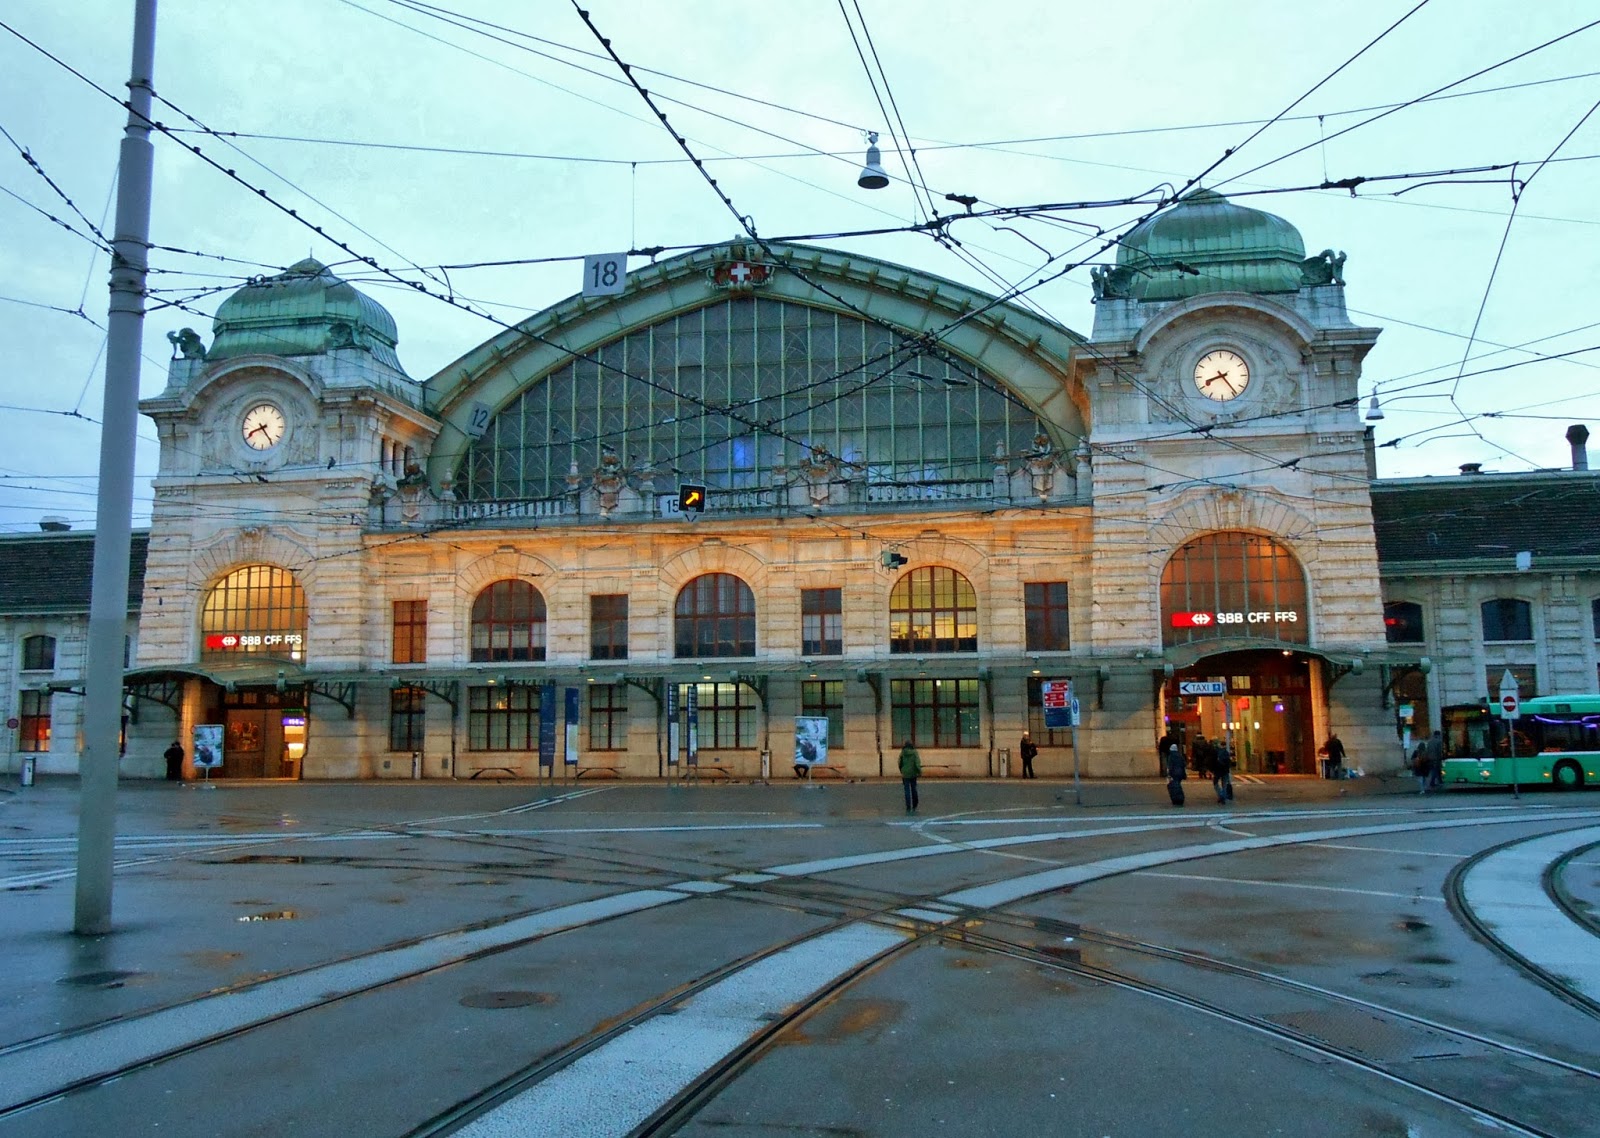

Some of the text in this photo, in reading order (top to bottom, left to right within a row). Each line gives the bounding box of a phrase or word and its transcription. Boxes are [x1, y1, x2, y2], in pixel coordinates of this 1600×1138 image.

[592, 261, 618, 288] 18
[472, 408, 488, 429] 12
[1216, 611, 1298, 624] SBB CFF FFS
[240, 634, 302, 646] SBB CFF FFS
[1191, 683, 1210, 692] TAXI
